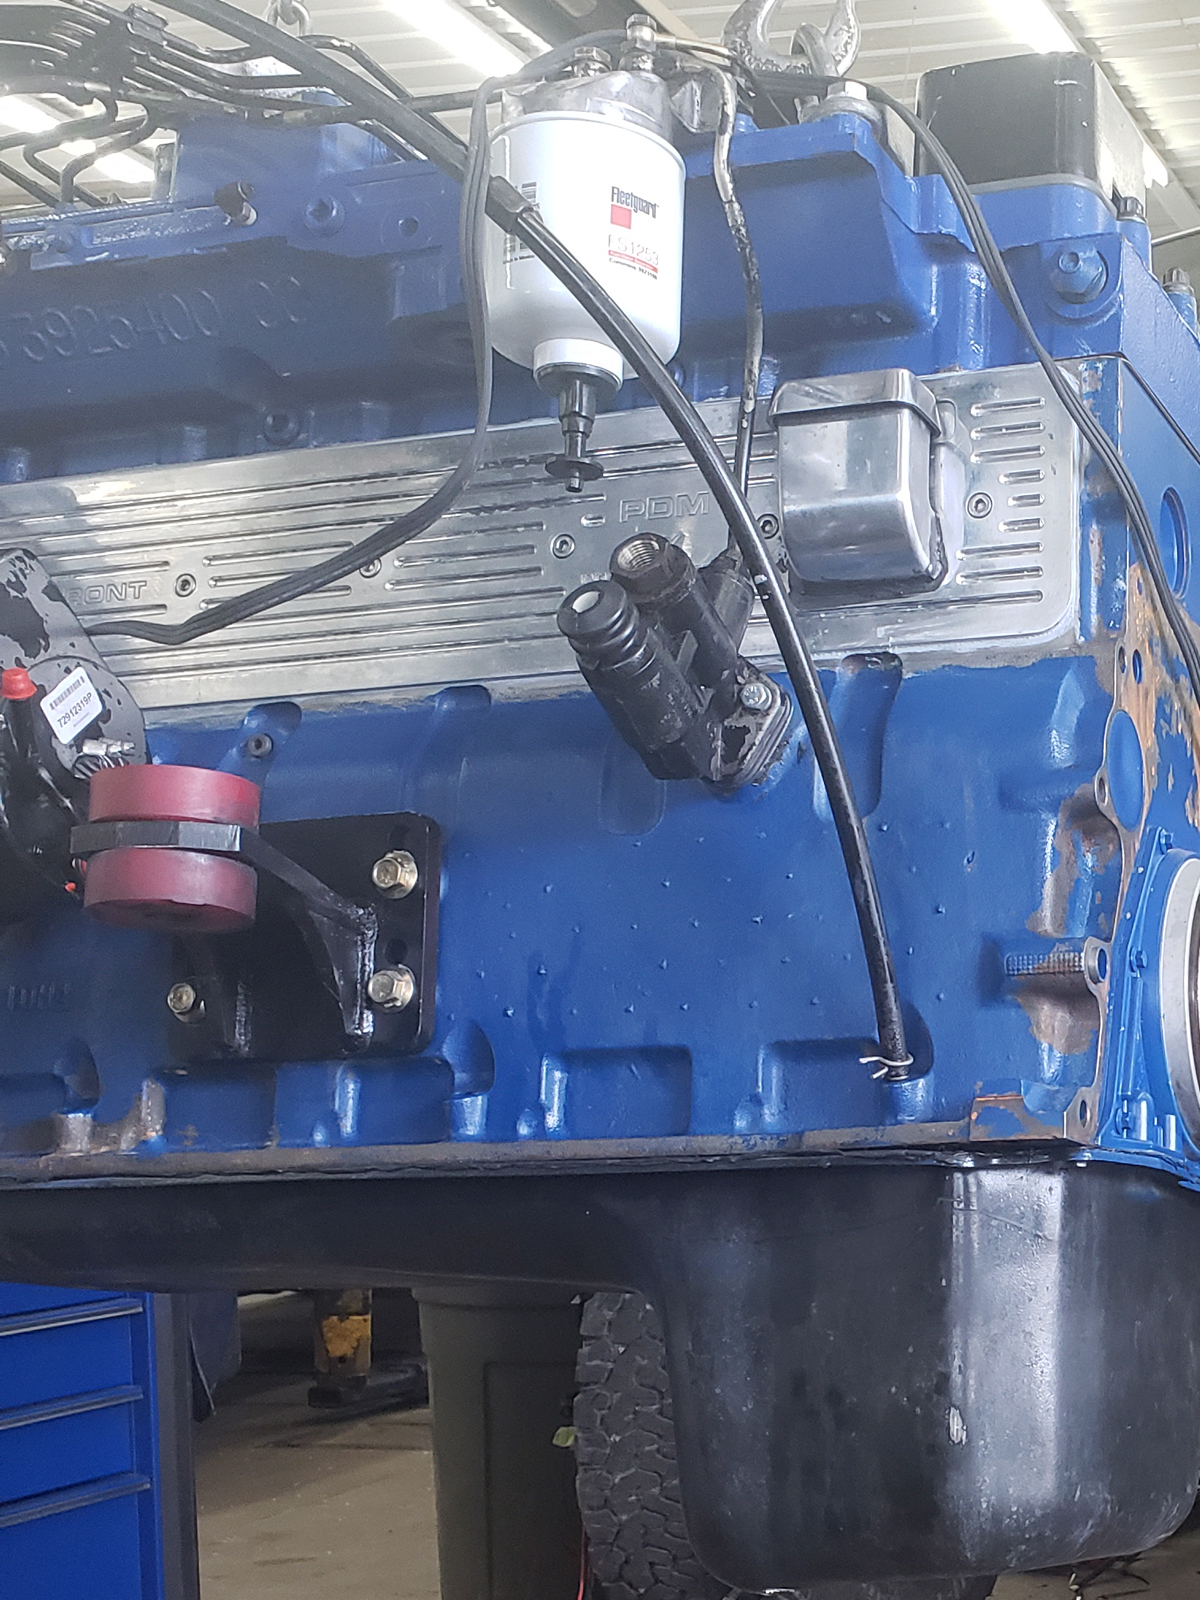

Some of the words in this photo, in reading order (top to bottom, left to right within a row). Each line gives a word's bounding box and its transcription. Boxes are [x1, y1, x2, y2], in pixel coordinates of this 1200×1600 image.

[611, 186, 657, 219] Fleetguard
[619, 490, 710, 523] PDM
[65, 580, 147, 606] RONT
